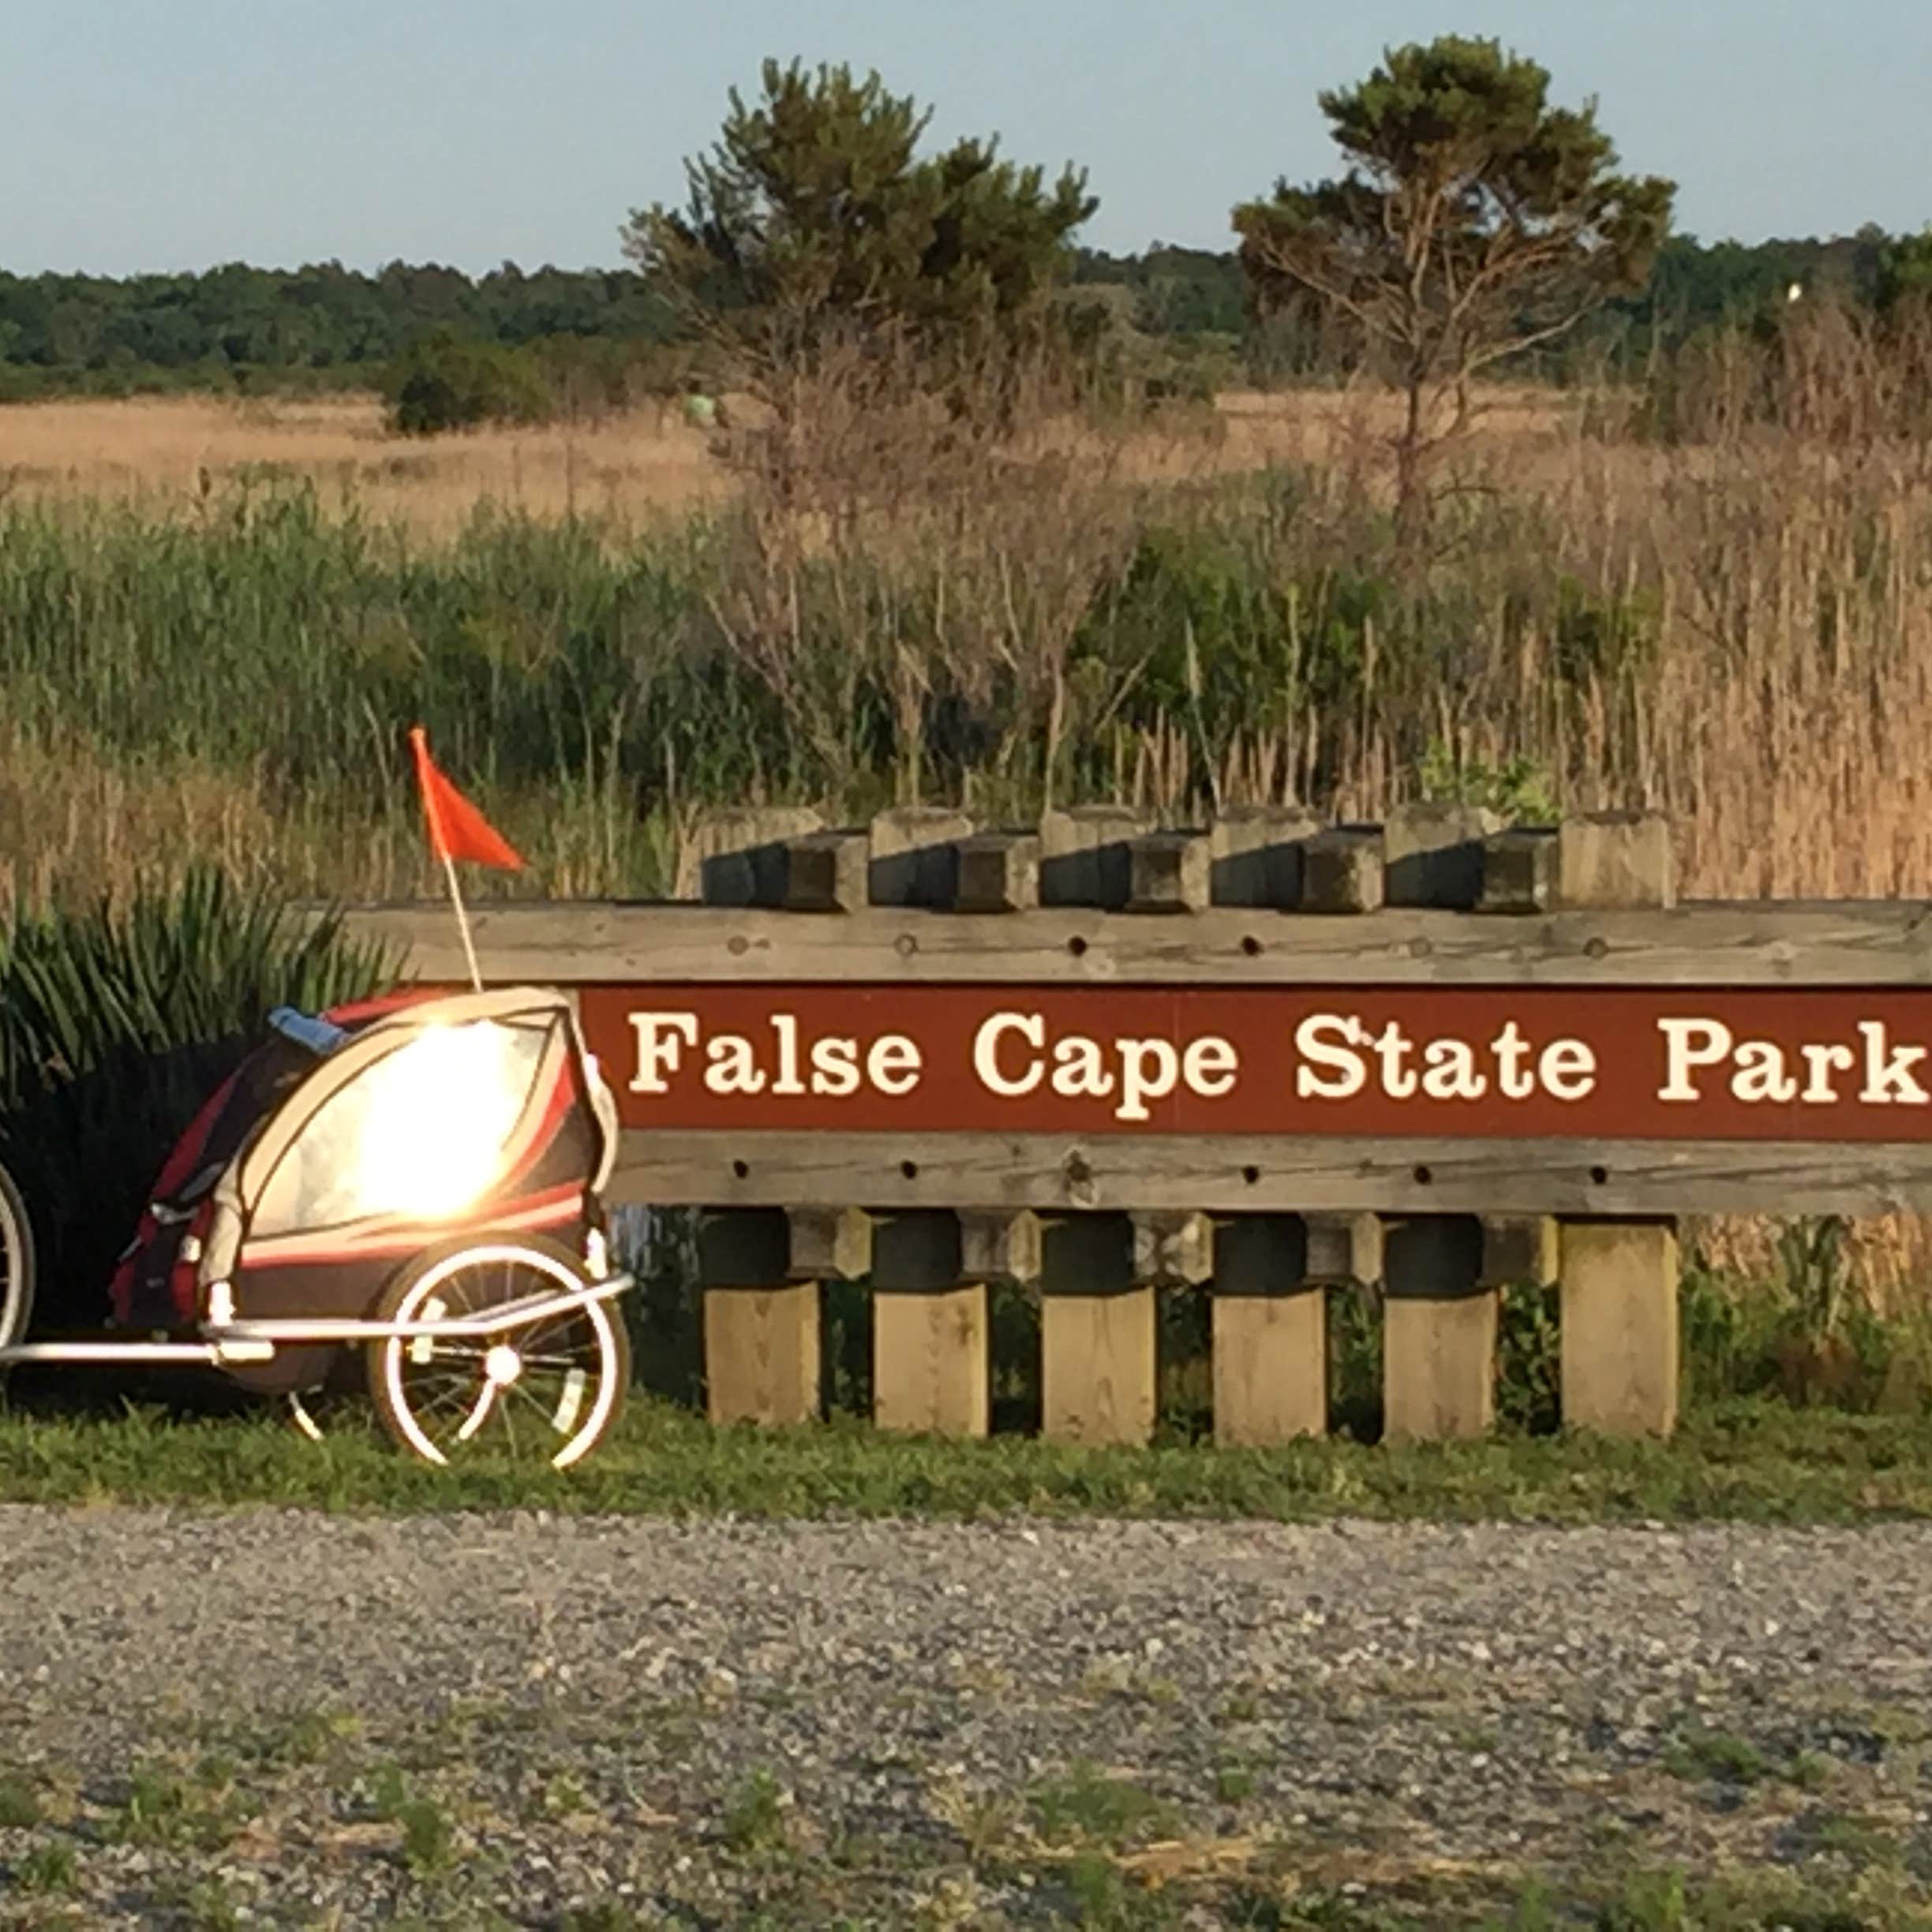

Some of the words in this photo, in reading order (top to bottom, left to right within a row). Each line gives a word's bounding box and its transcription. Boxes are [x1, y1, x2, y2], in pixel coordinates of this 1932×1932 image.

[628, 1012, 922, 1095] False
[974, 1013, 1238, 1121] Cape
[1295, 1014, 1597, 1100] State
[1657, 1018, 1930, 1104] Park
